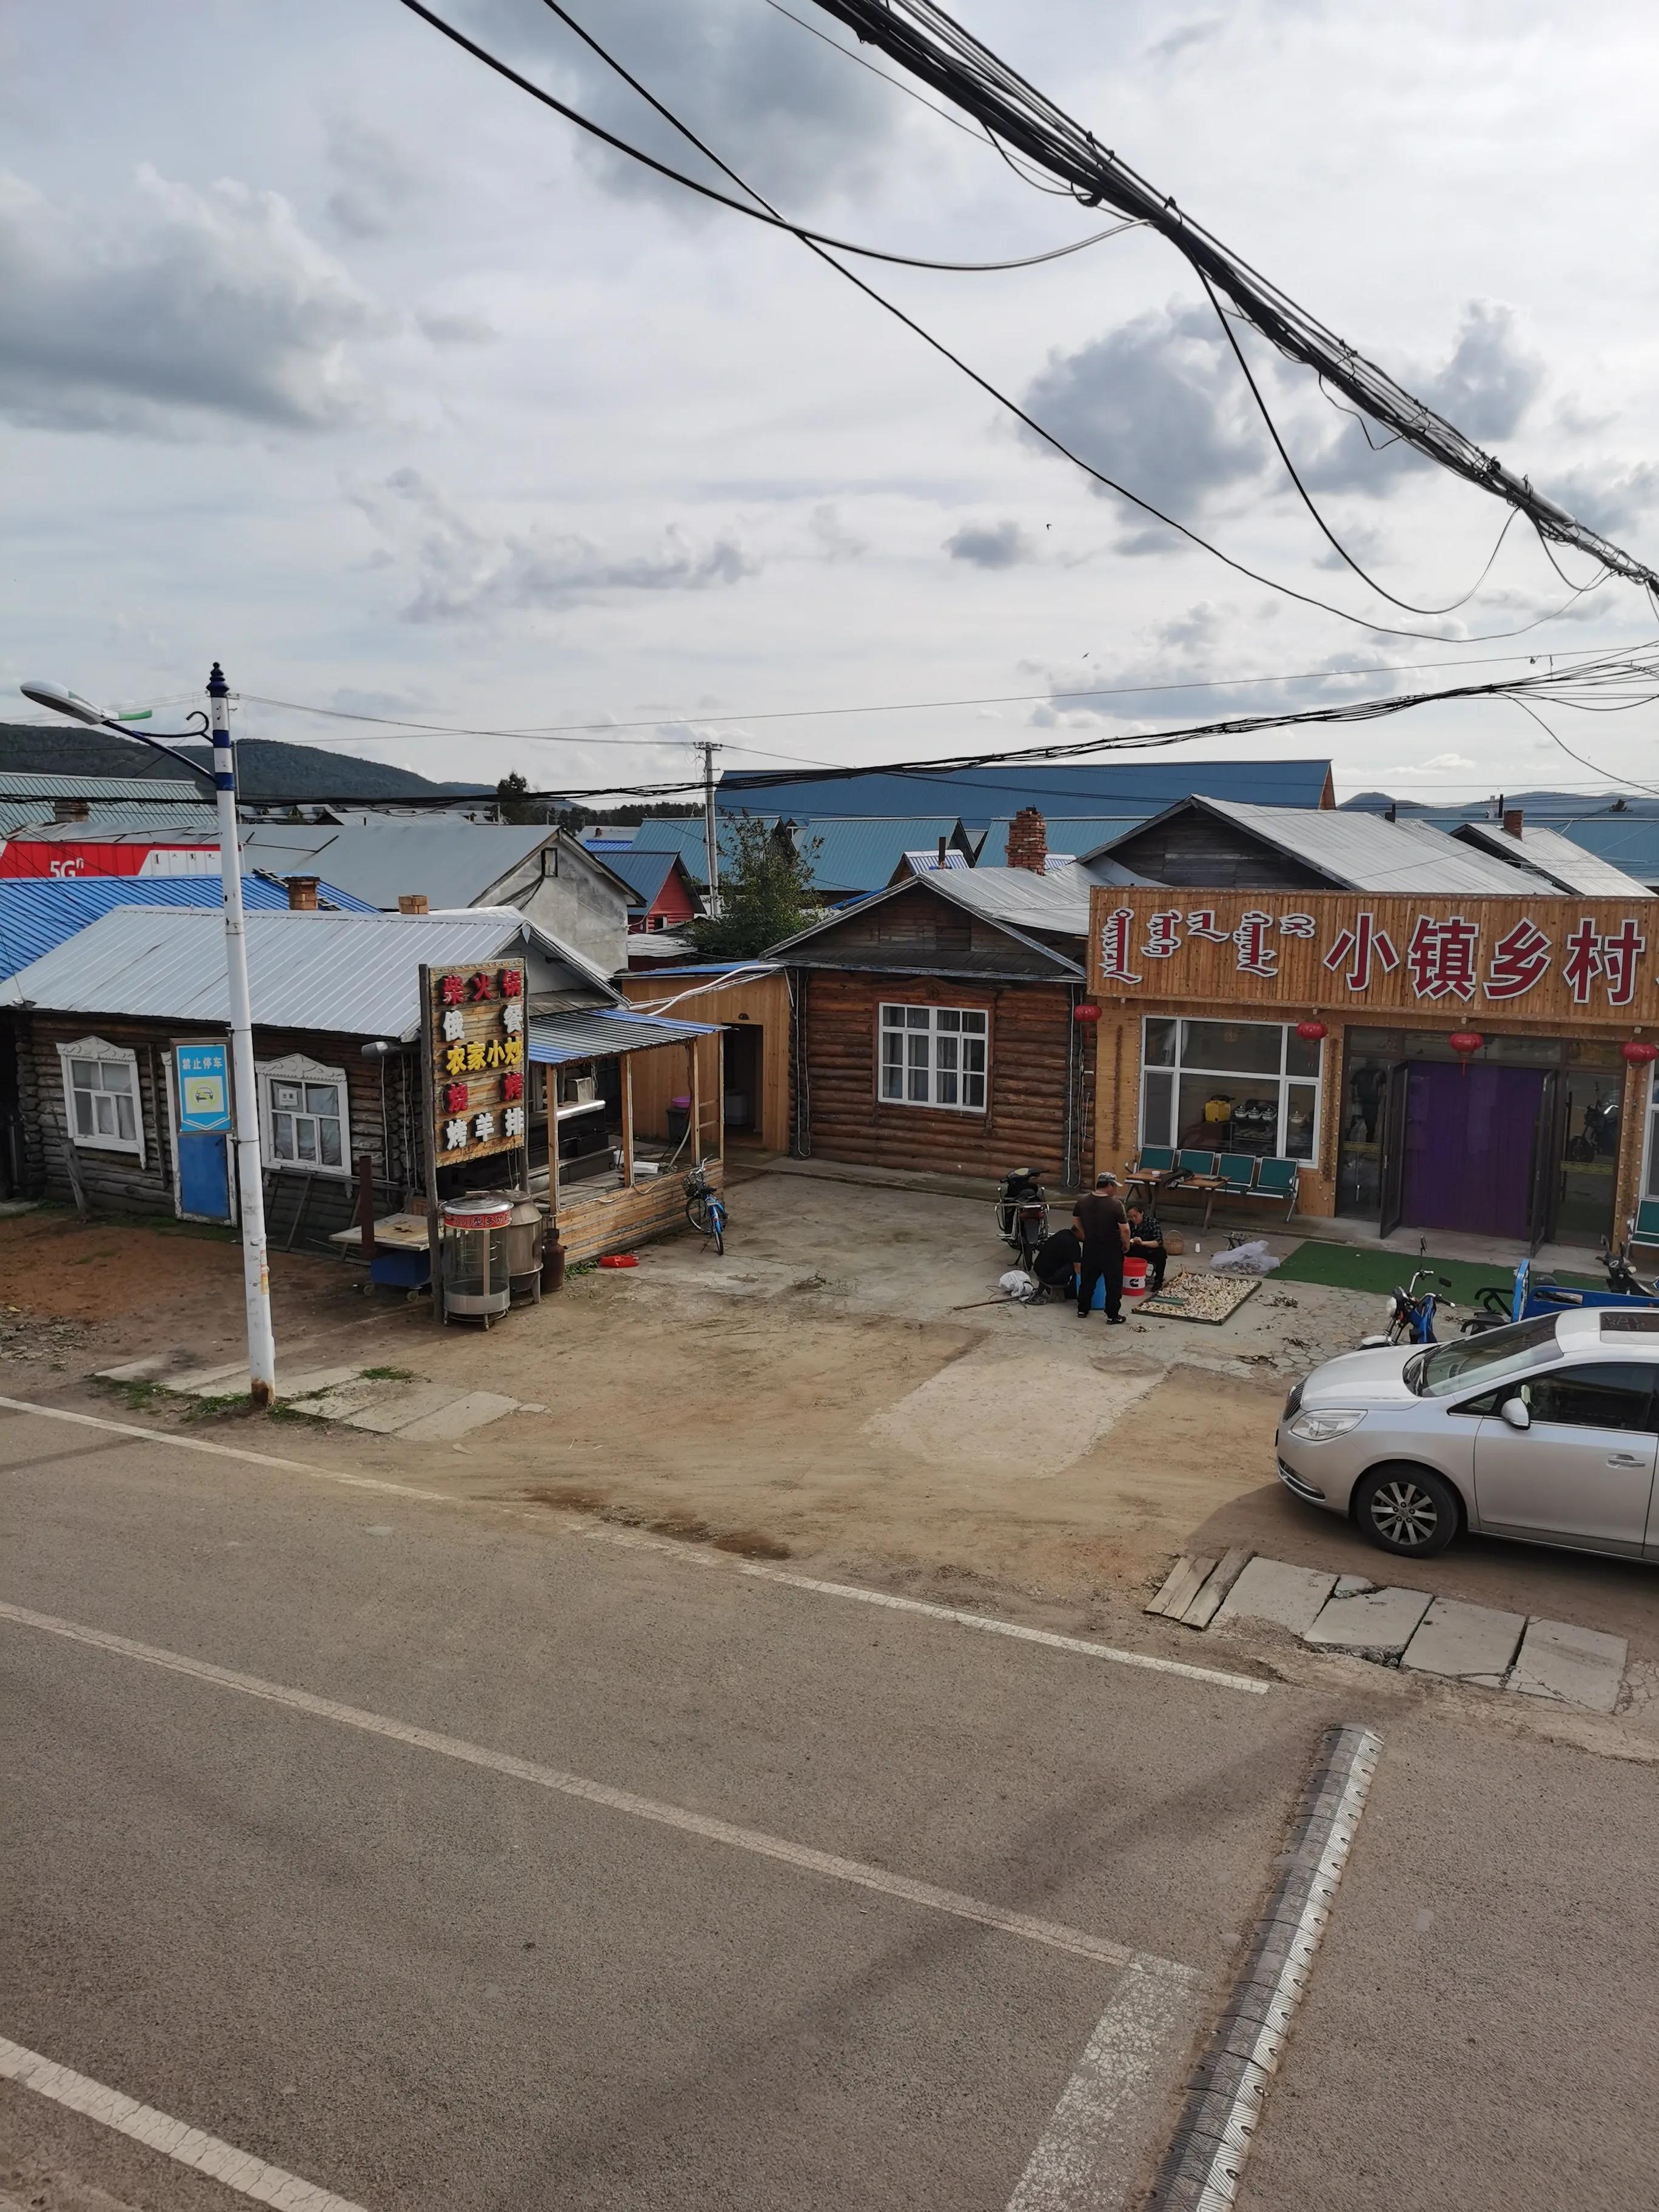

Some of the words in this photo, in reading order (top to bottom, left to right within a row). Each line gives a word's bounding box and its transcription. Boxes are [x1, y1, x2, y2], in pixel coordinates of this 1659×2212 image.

[1323, 911, 1659, 1007] 小镇乡村
[443, 970, 521, 1005] 柴火锅
[183, 1057, 223, 1070] 禁止停车
[446, 1036, 522, 1076] 农家小炒
[446, 1107, 524, 1150] 烤羊排
